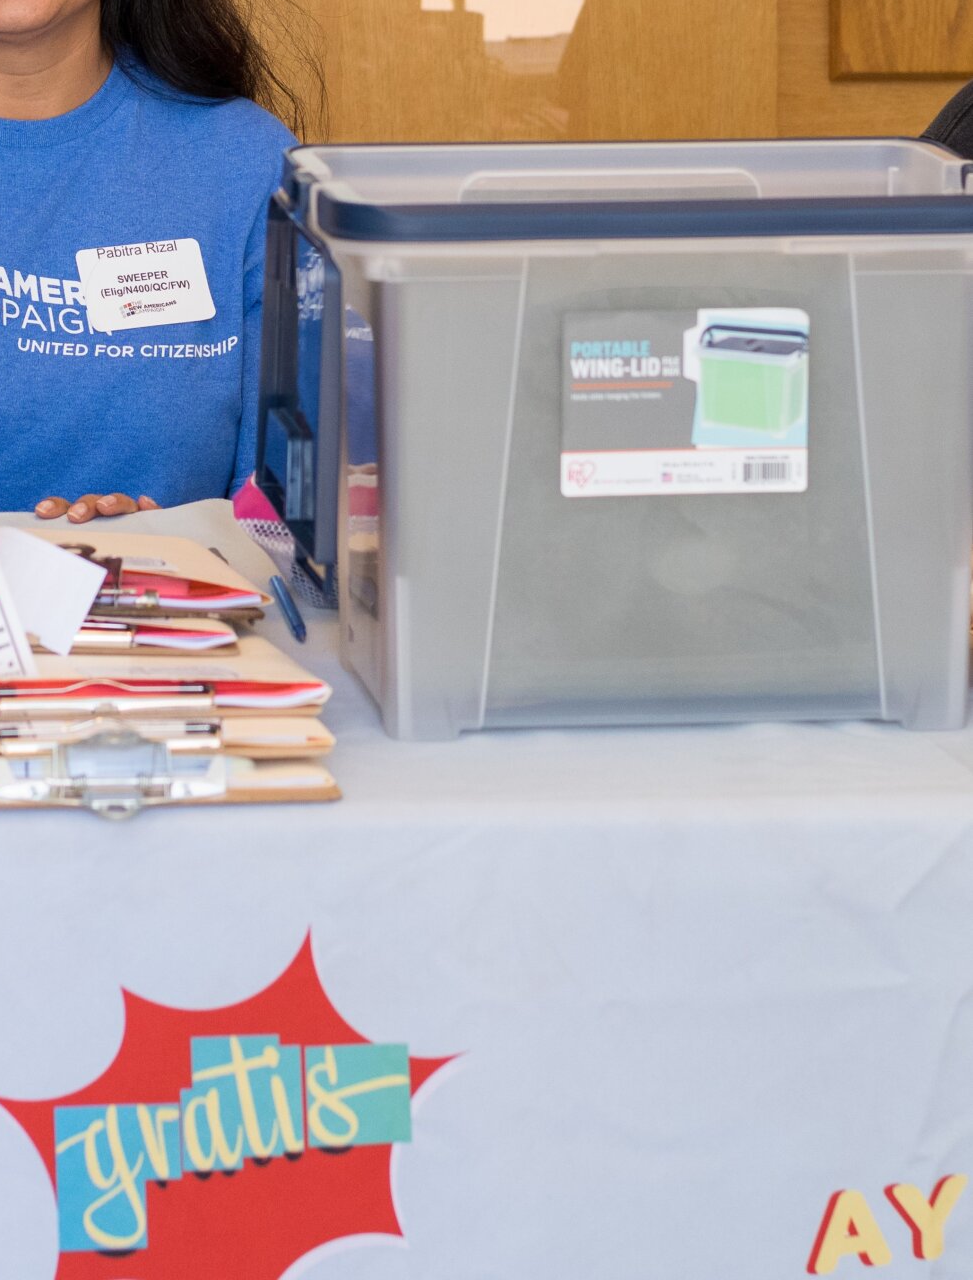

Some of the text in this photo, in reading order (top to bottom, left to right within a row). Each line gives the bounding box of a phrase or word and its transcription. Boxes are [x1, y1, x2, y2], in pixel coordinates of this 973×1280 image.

[96, 240, 178, 259] Pabitra Rizal
[117, 270, 169, 283] SWEEPER
[100, 279, 191, 299] (Elig/N400/QC/FW)
[128, 299, 177, 312] NEW AMERICANS
[17, 335, 238, 359] UNITED FOR CITIZENSHIP
[570, 339, 651, 358] PORTABLE
[570, 356, 661, 379] WING-LID
[55, 1034, 410, 1249] gratis
[806, 1173, 970, 1275] AY
